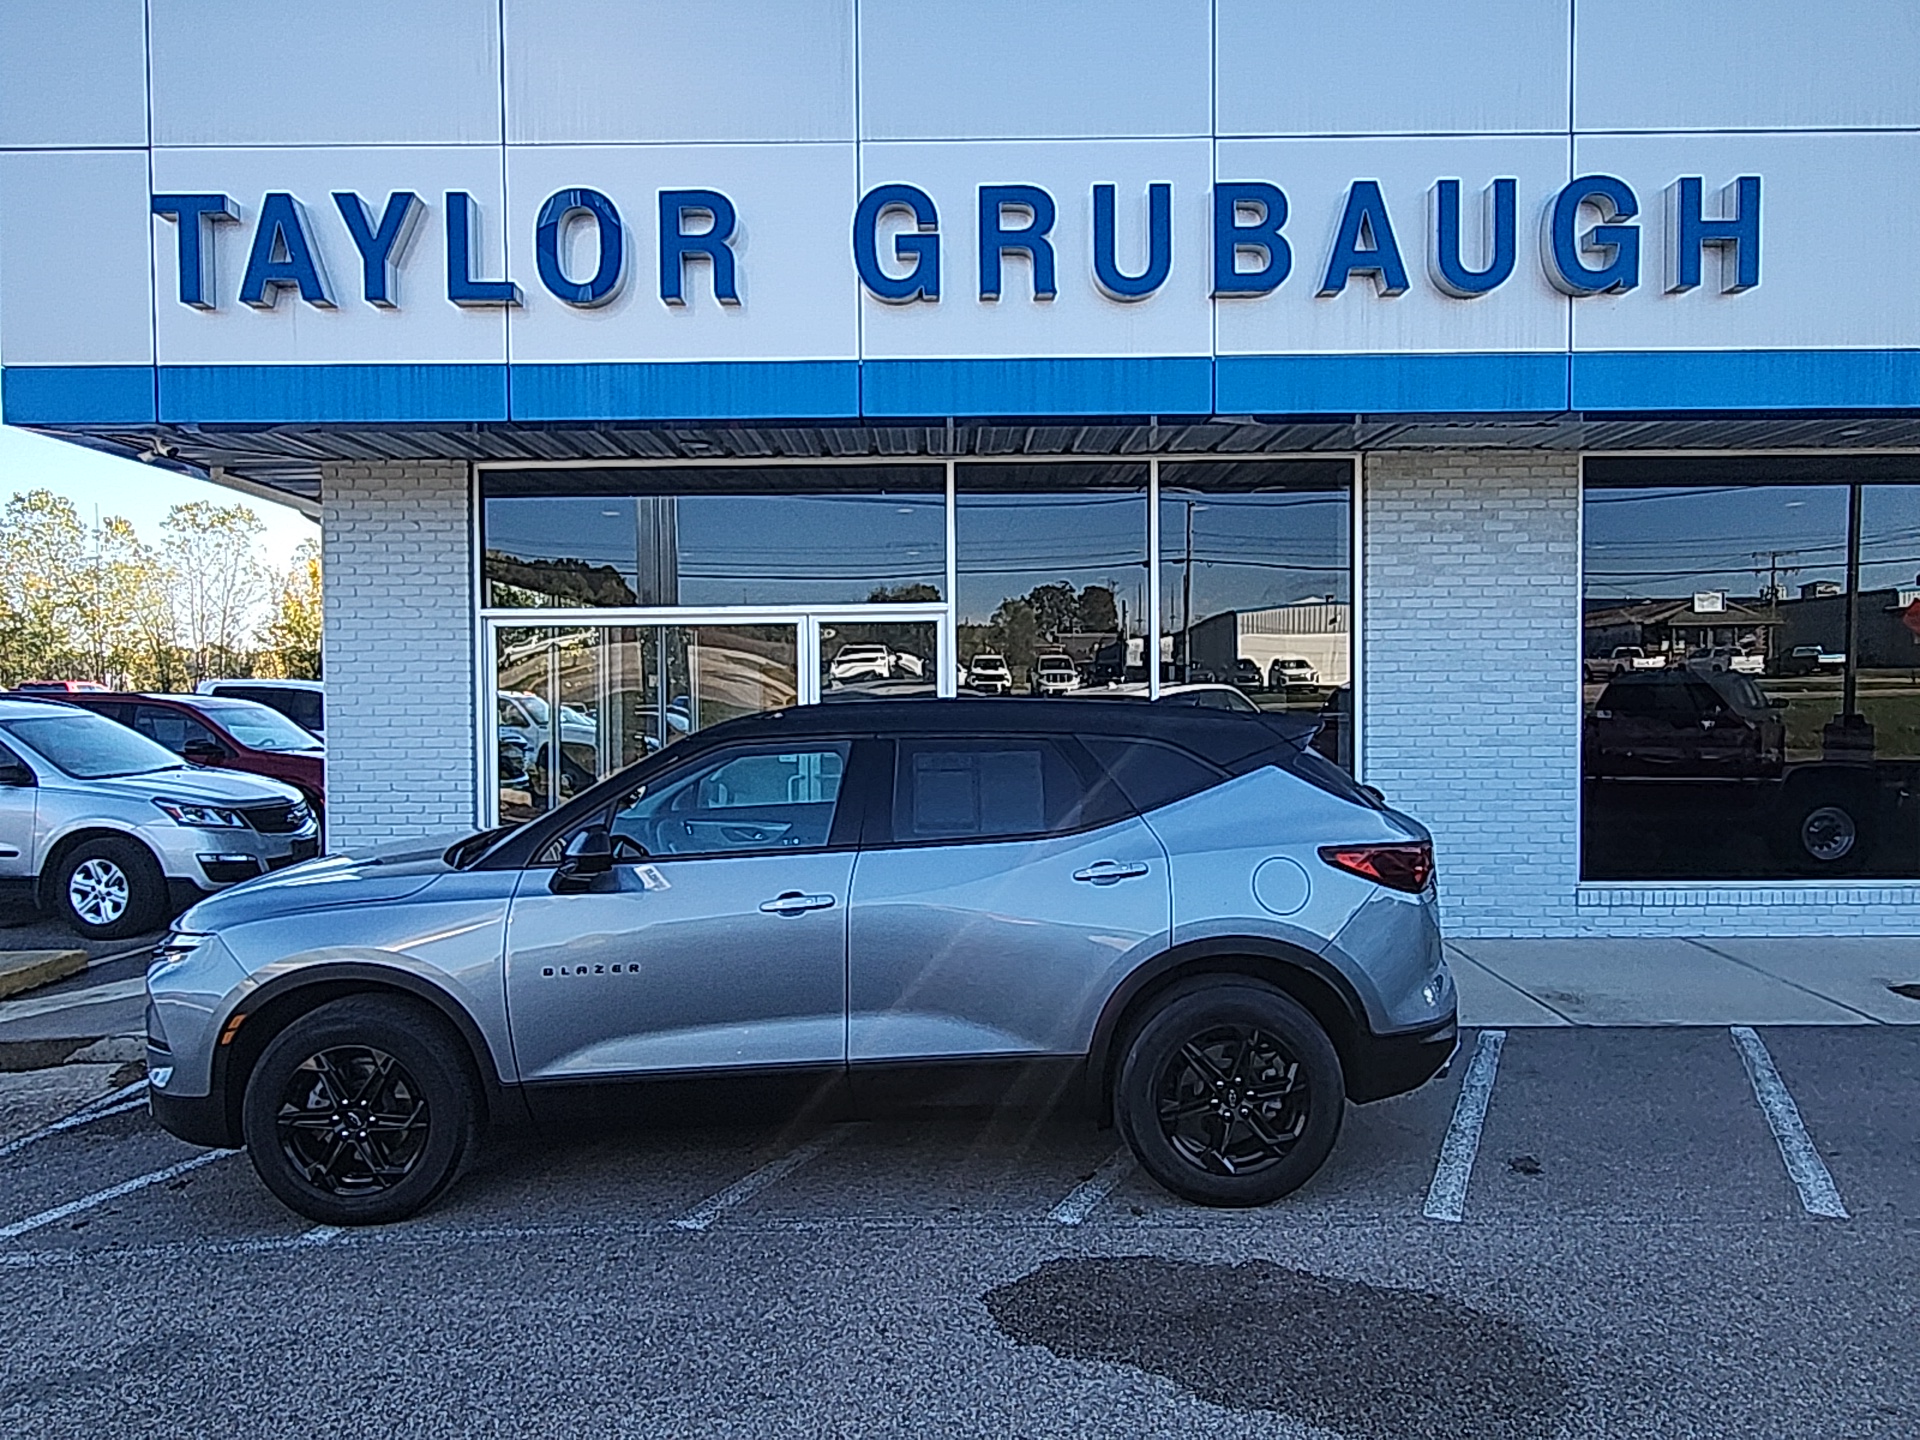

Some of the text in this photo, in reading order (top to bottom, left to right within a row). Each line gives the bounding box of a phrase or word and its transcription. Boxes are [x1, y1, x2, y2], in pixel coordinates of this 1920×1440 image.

[152, 174, 1762, 309] TAYLOR GRUBAUGH
[542, 963, 640, 977] BLAZER
